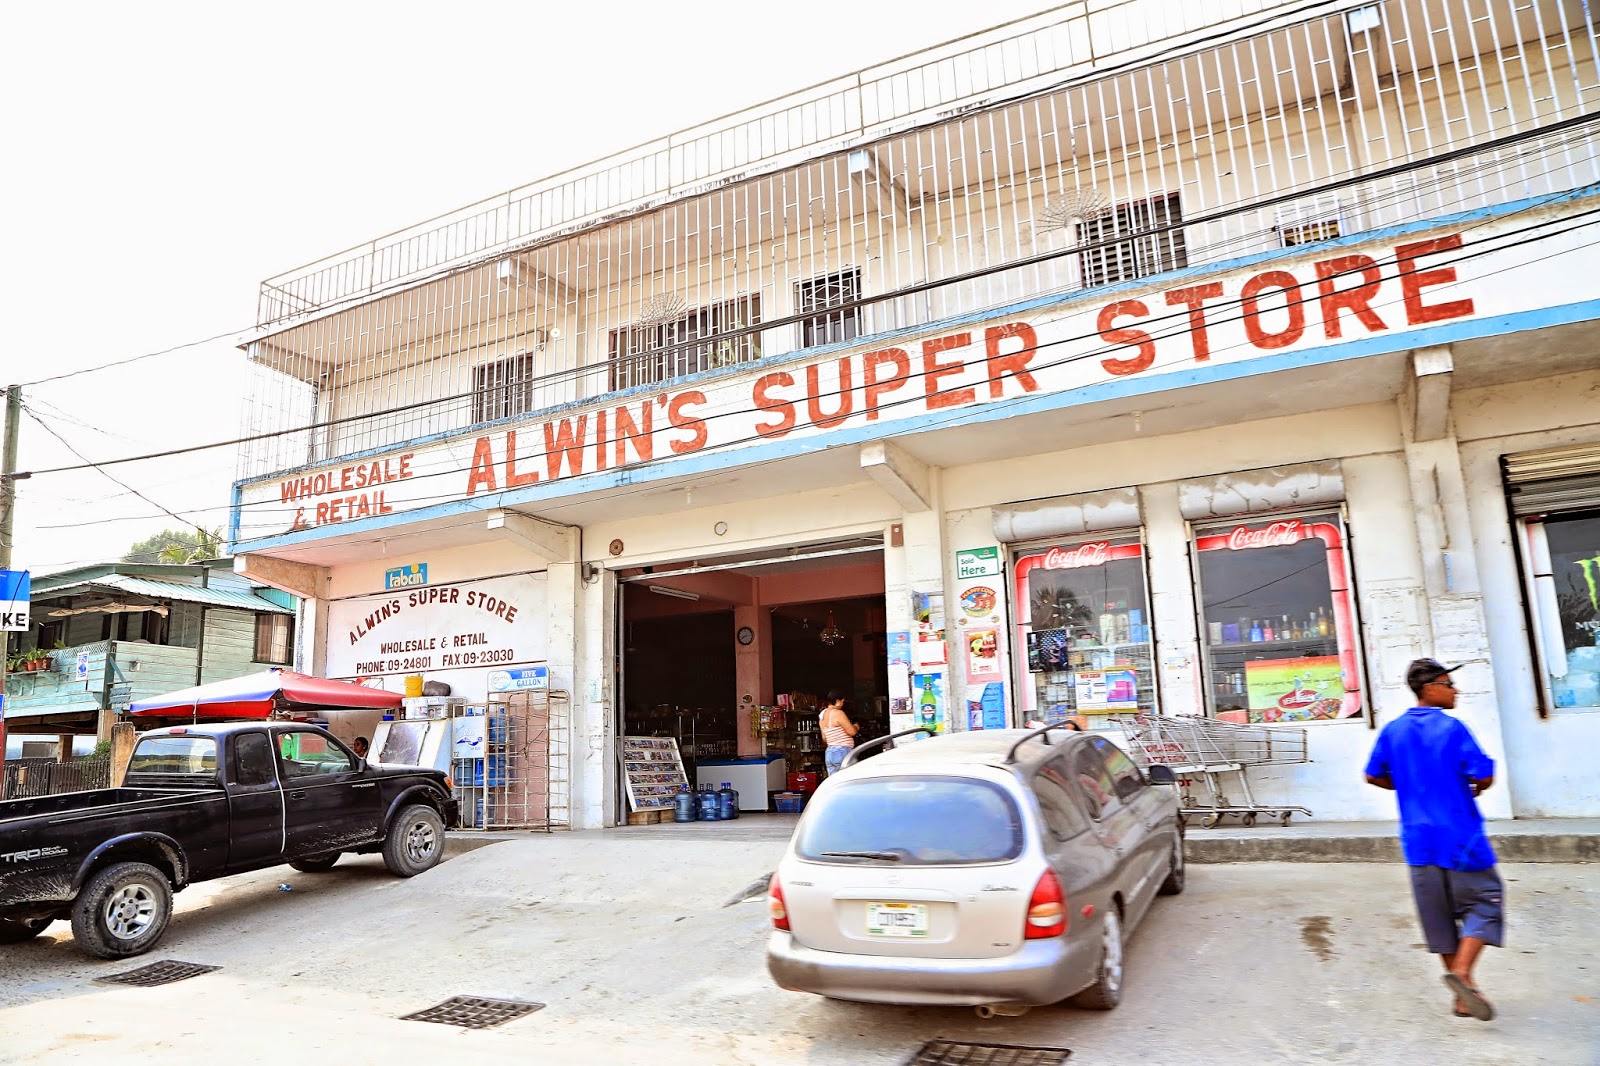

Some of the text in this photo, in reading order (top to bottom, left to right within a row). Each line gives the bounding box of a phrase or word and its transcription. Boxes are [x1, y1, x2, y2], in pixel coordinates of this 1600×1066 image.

[466, 234, 1475, 497] ALWIN'S SUPER STORE
[281, 453, 414, 504] WHOLESALE
[293, 490, 393, 530] & RETAIL
[1230, 521, 1300, 550] Coca-Cola
[1044, 542, 1108, 570] Coca-Cola
[961, 566, 986, 576] Here
[0, 612, 26, 627] KE
[349, 588, 518, 646] ALWIN'S SUPER STORE
[380, 632, 488, 655] WHOLESALE & RETAIL
[516, 678, 541, 687] GALLON
[521, 670, 537, 678] FIVE
[1, 849, 41, 863] TRD
